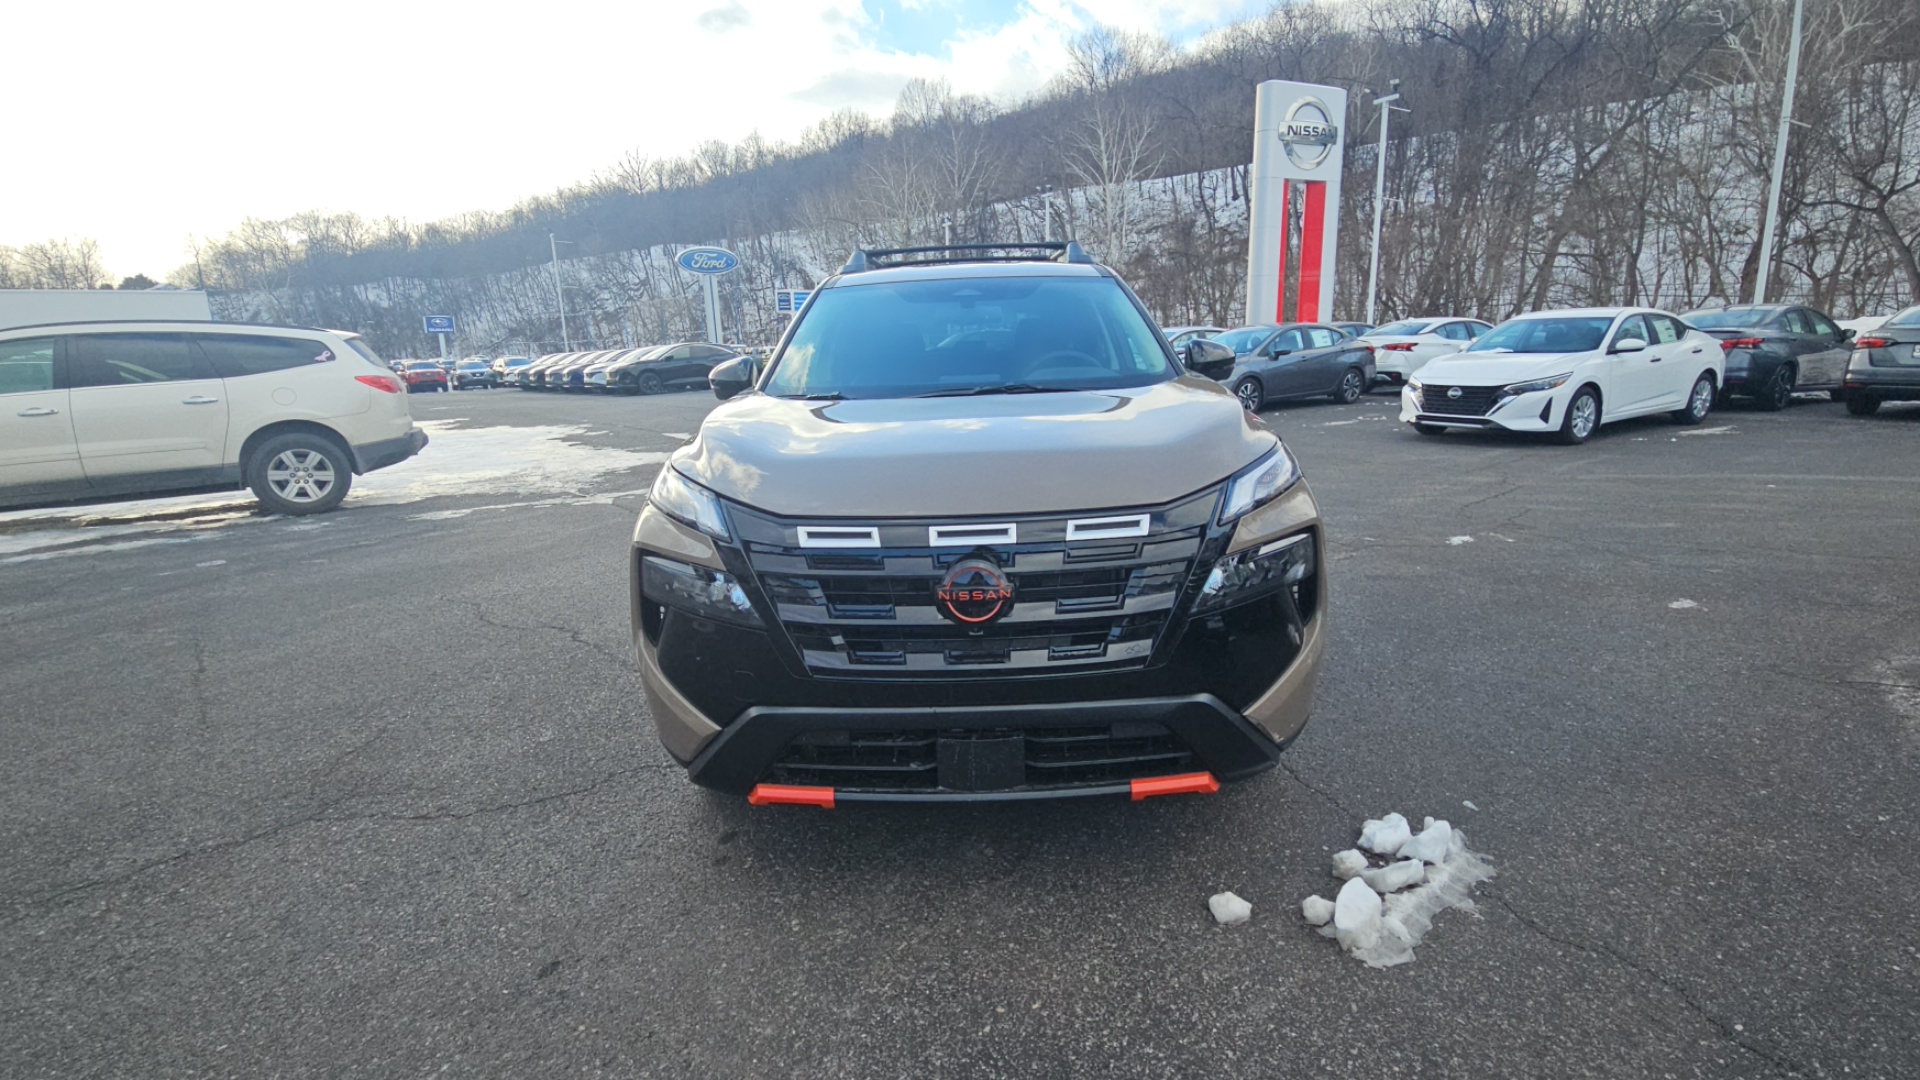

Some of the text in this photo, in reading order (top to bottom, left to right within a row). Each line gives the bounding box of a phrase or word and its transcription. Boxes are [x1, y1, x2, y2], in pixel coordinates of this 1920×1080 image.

[1287, 124, 1334, 139] NISSAN
[691, 252, 727, 269] Ford
[938, 589, 1012, 602] NISSAN
